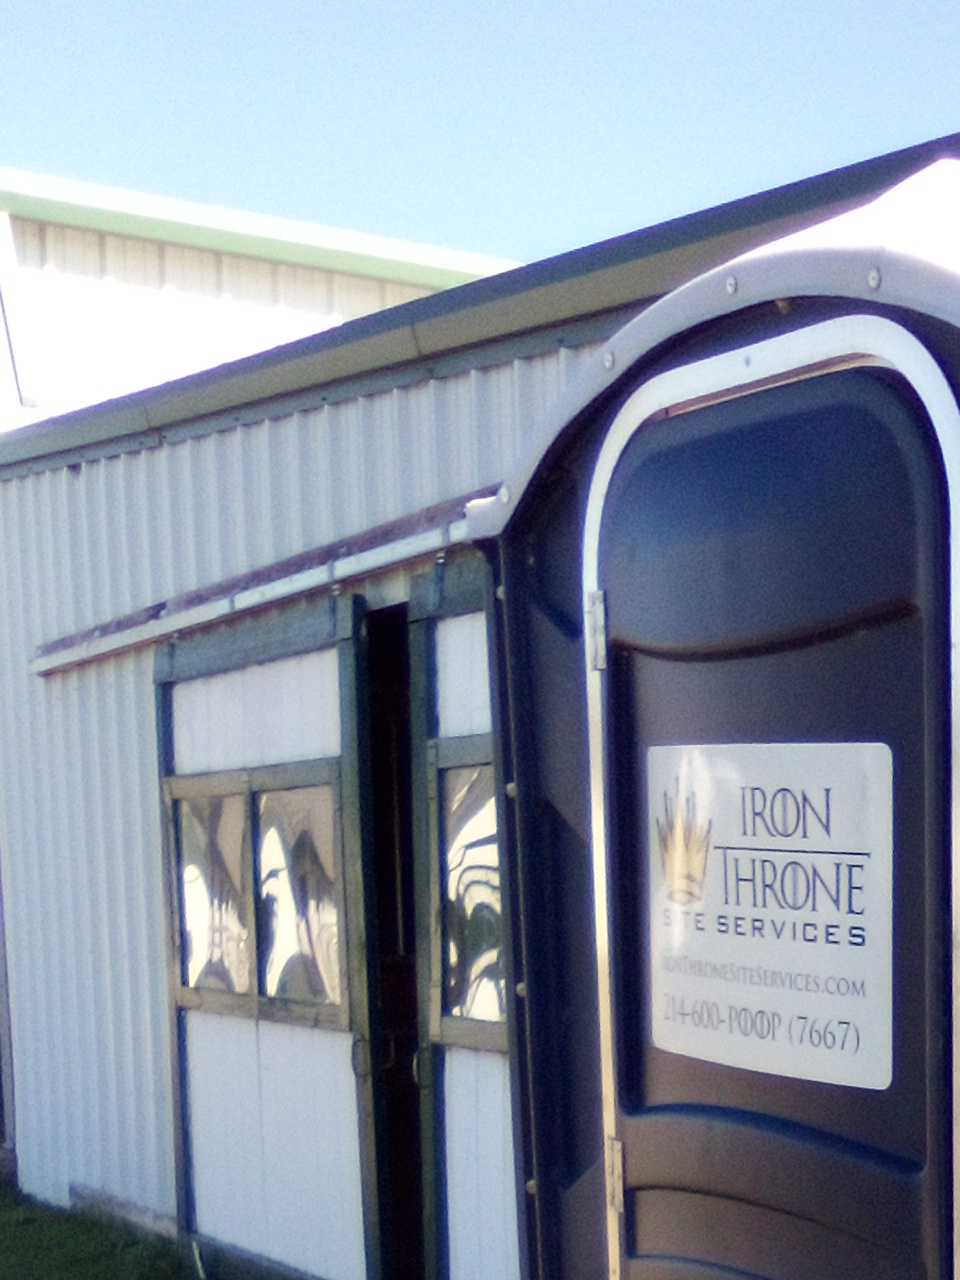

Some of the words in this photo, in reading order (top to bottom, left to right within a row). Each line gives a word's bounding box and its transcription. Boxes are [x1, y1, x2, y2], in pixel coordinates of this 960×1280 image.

[740, 786, 833, 839] IRON
[714, 847, 869, 916] THRONE
[662, 907, 706, 932] STE
[716, 915, 867, 947] SERVICES
[661, 956, 867, 999] NTHRONESITESERVICES.COM
[787, 1015, 861, 1056] (7667)
